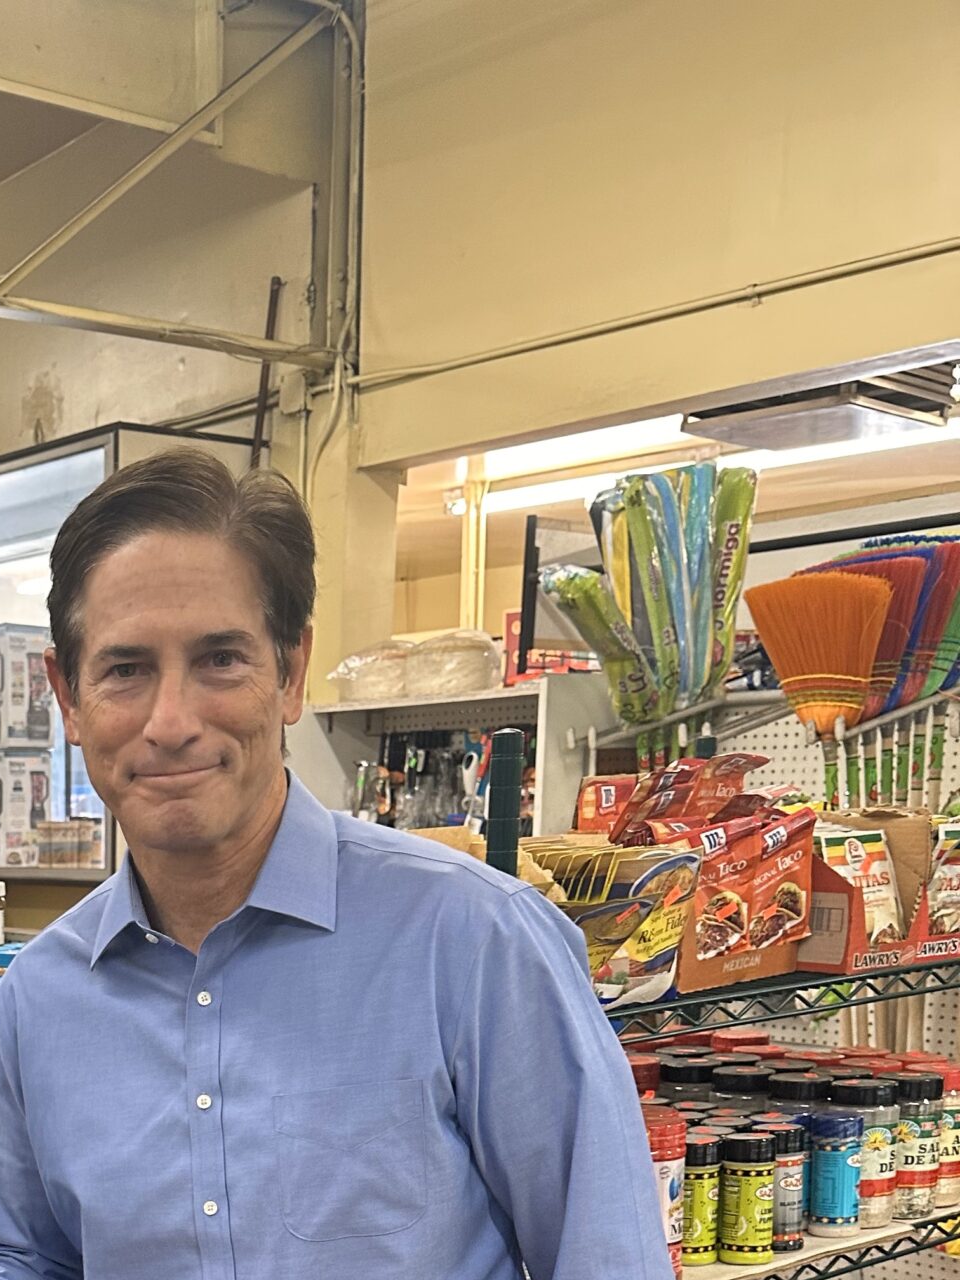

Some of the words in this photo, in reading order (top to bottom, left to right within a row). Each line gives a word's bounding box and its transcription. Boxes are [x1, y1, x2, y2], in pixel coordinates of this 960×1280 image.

[775, 850, 803, 871] Taco
[916, 939, 958, 957] LAWRY'S
[722, 955, 761, 973] MEXICAN
[853, 950, 899, 968] LAWRY'S
[903, 1155, 925, 1166] DE
